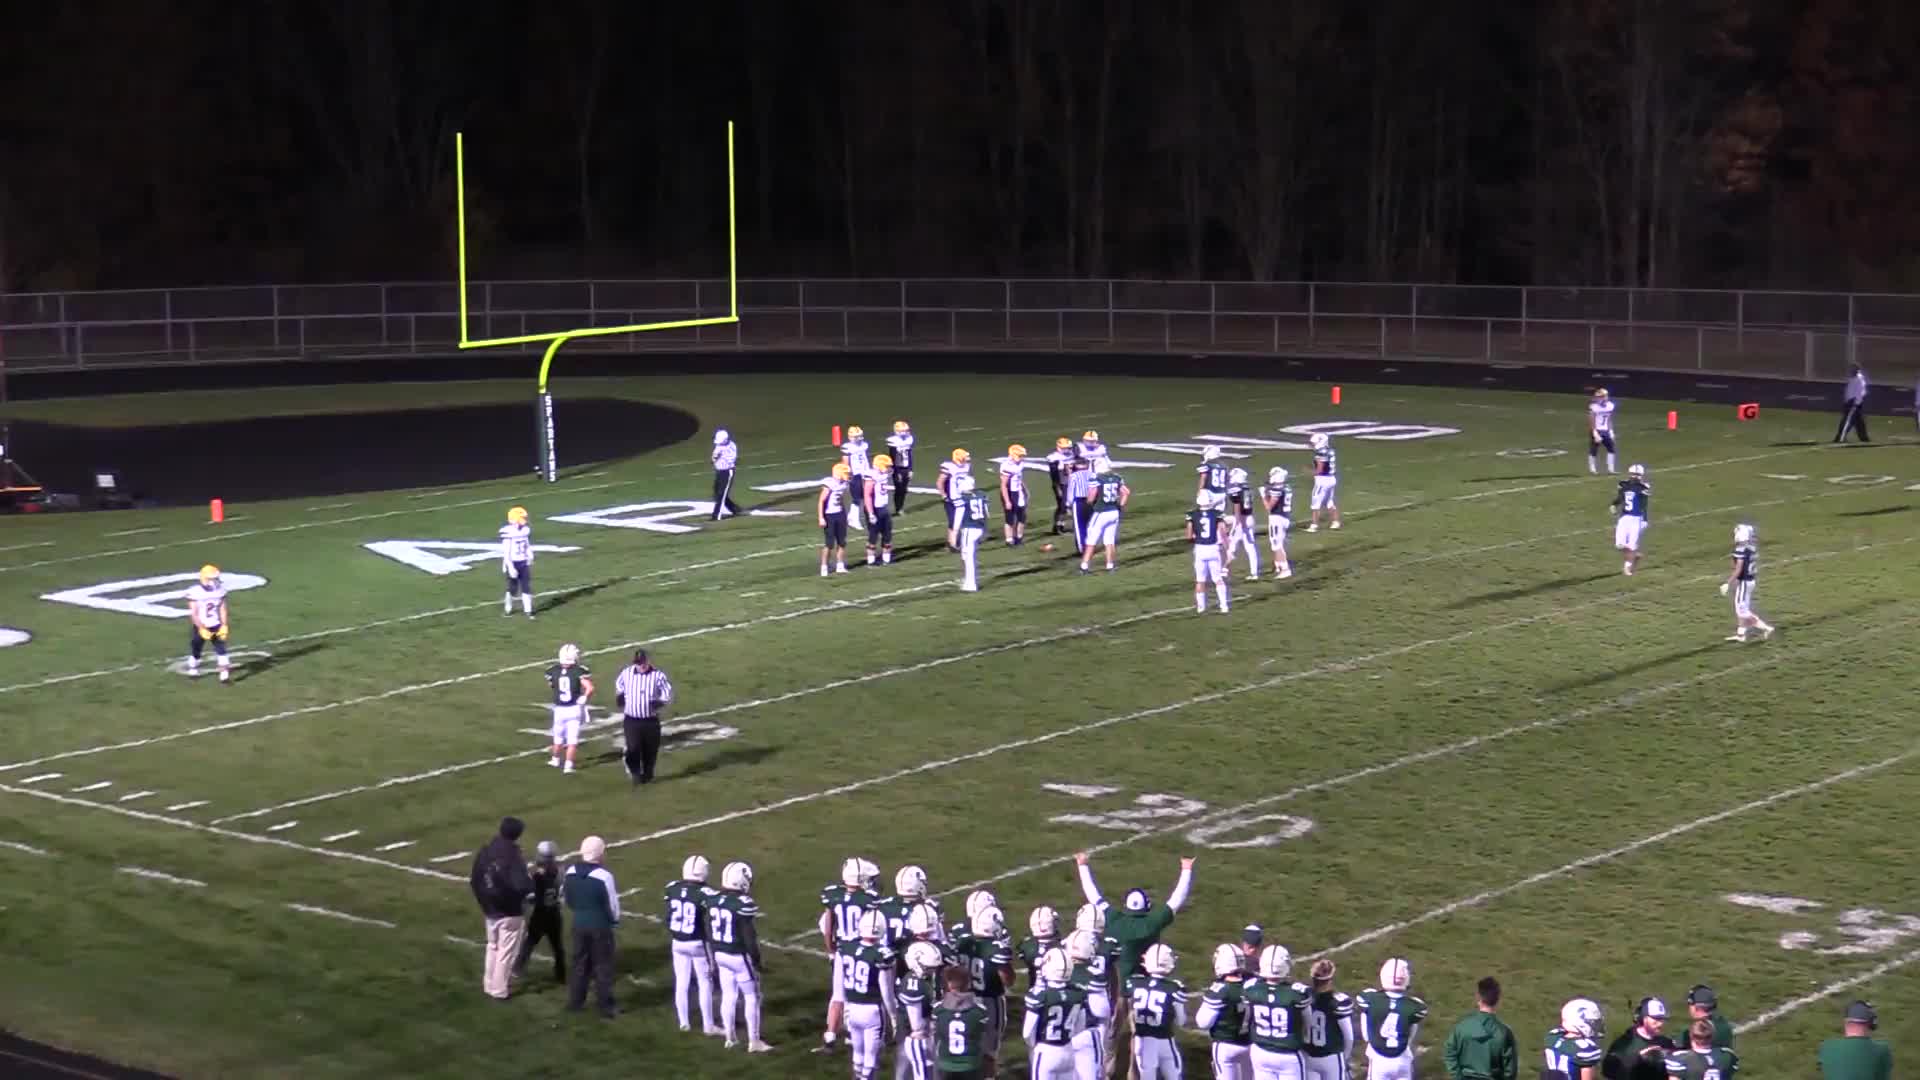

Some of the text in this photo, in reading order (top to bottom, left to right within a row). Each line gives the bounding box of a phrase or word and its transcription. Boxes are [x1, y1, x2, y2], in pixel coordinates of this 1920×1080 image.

[1744, 405, 1757, 419] G
[545, 395, 556, 482] SPARTANS
[970, 498, 985, 520] 51
[1103, 482, 1119, 503] 55
[1624, 490, 1637, 512] 5
[1199, 517, 1212, 540] 3
[558, 676, 572, 703] 9
[1047, 793, 1314, 849] 20
[709, 906, 734, 943] 27
[835, 903, 863, 942] 10
[843, 954, 870, 994] 39
[1046, 1003, 1087, 1041] 24
[1133, 987, 1168, 1027] 25
[1253, 1004, 1289, 1039] 59
[948, 1020, 966, 1055] 6
[1380, 1012, 1400, 1048] 4
